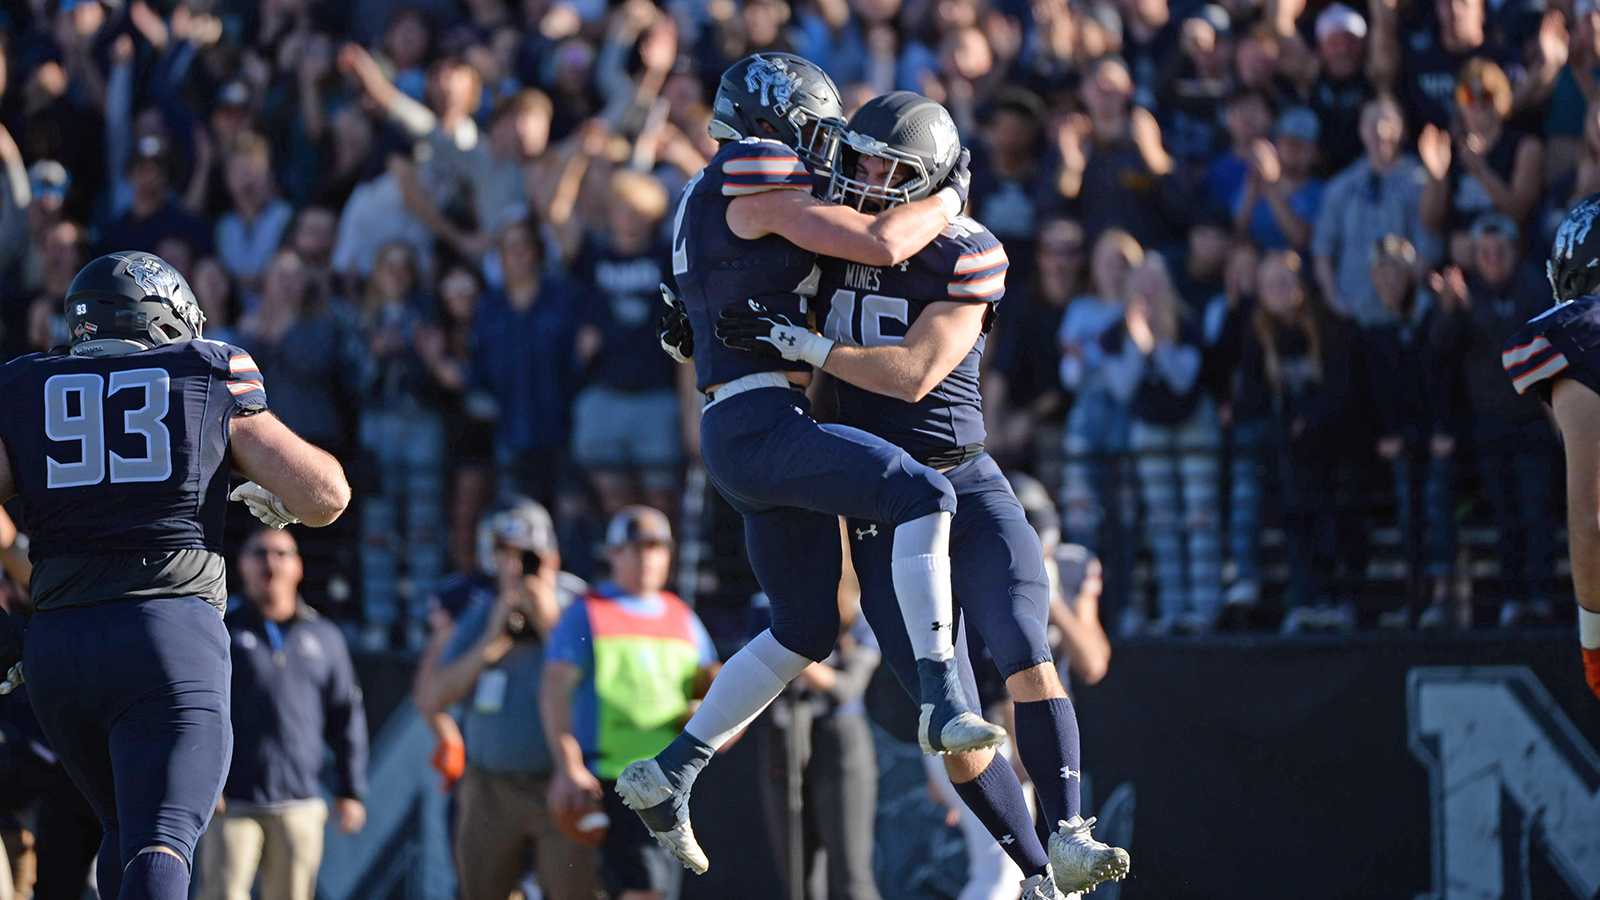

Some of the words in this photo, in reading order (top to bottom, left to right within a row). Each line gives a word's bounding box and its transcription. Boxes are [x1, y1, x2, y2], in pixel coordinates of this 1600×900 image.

[844, 263, 882, 291] MINES
[76, 303, 87, 315] 93
[45, 368, 172, 488] 93
